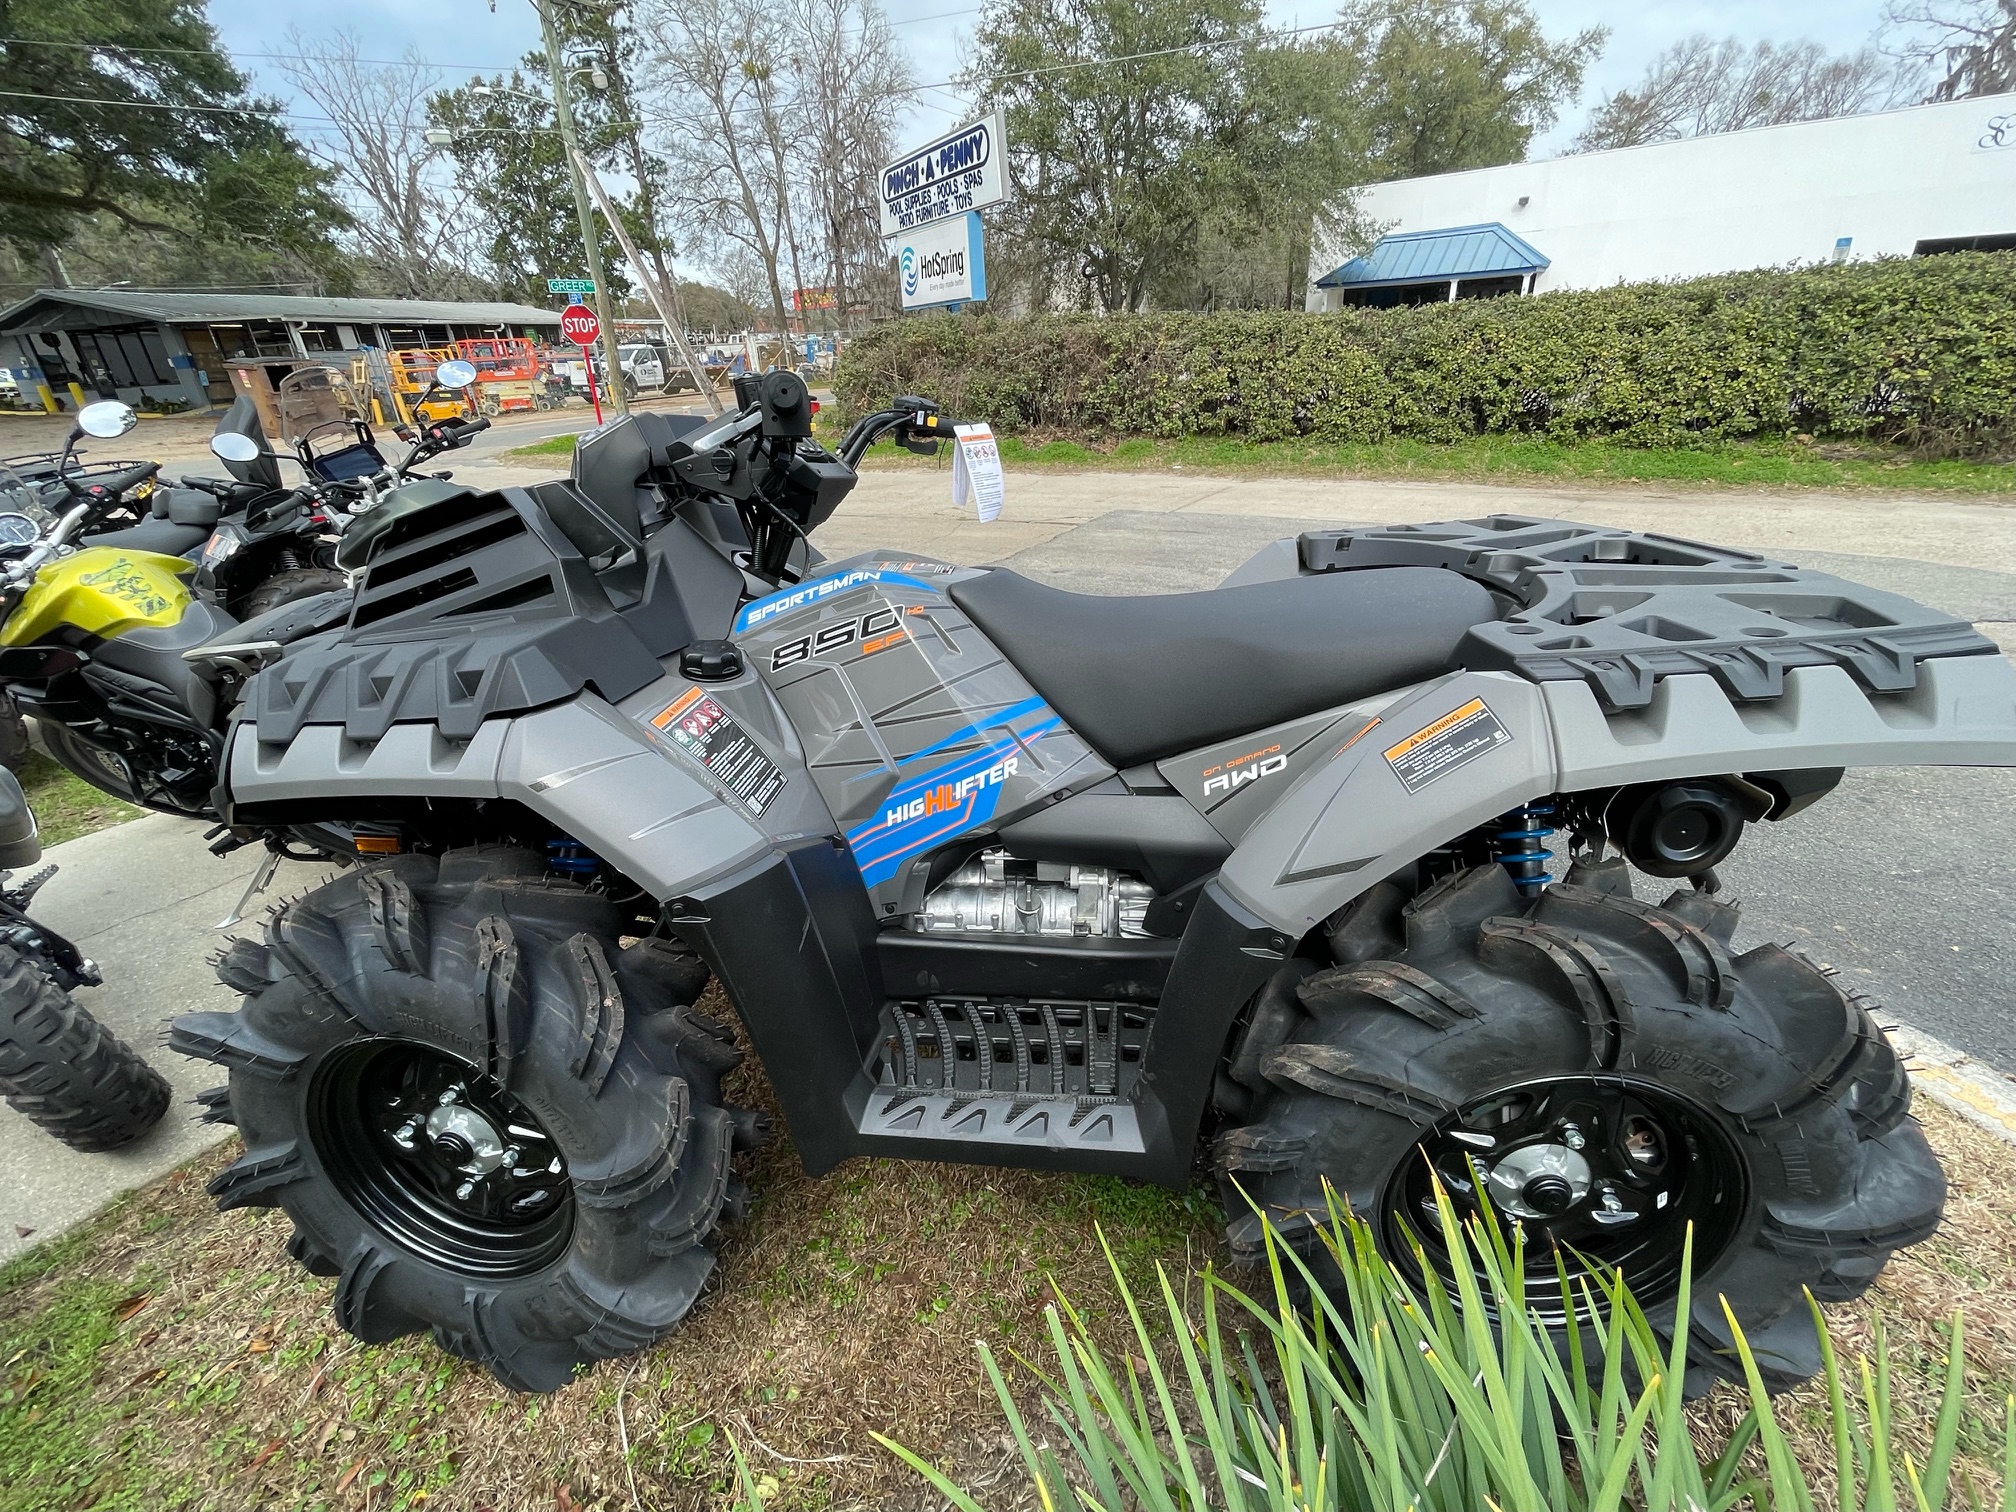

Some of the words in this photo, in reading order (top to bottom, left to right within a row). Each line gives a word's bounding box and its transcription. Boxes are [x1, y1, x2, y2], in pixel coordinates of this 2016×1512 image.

[889, 202, 903, 217] POOL
[904, 189, 932, 212] SUPPLIES
[936, 178, 959, 200] POOLS
[963, 169, 983, 191] SPAS
[898, 211, 914, 229] PATIO
[916, 198, 950, 220] FURNITURE
[954, 192, 973, 210] TOYS
[920, 248, 964, 280] HotSpring
[551, 281, 586, 291] GREER
[564, 318, 596, 333] STOP
[747, 571, 882, 625] SPORTSMAN
[770, 604, 906, 674] 850
[1417, 713, 1461, 741] WARNING
[1226, 744, 1281, 768] DEMAND
[1203, 754, 1288, 797] AWD
